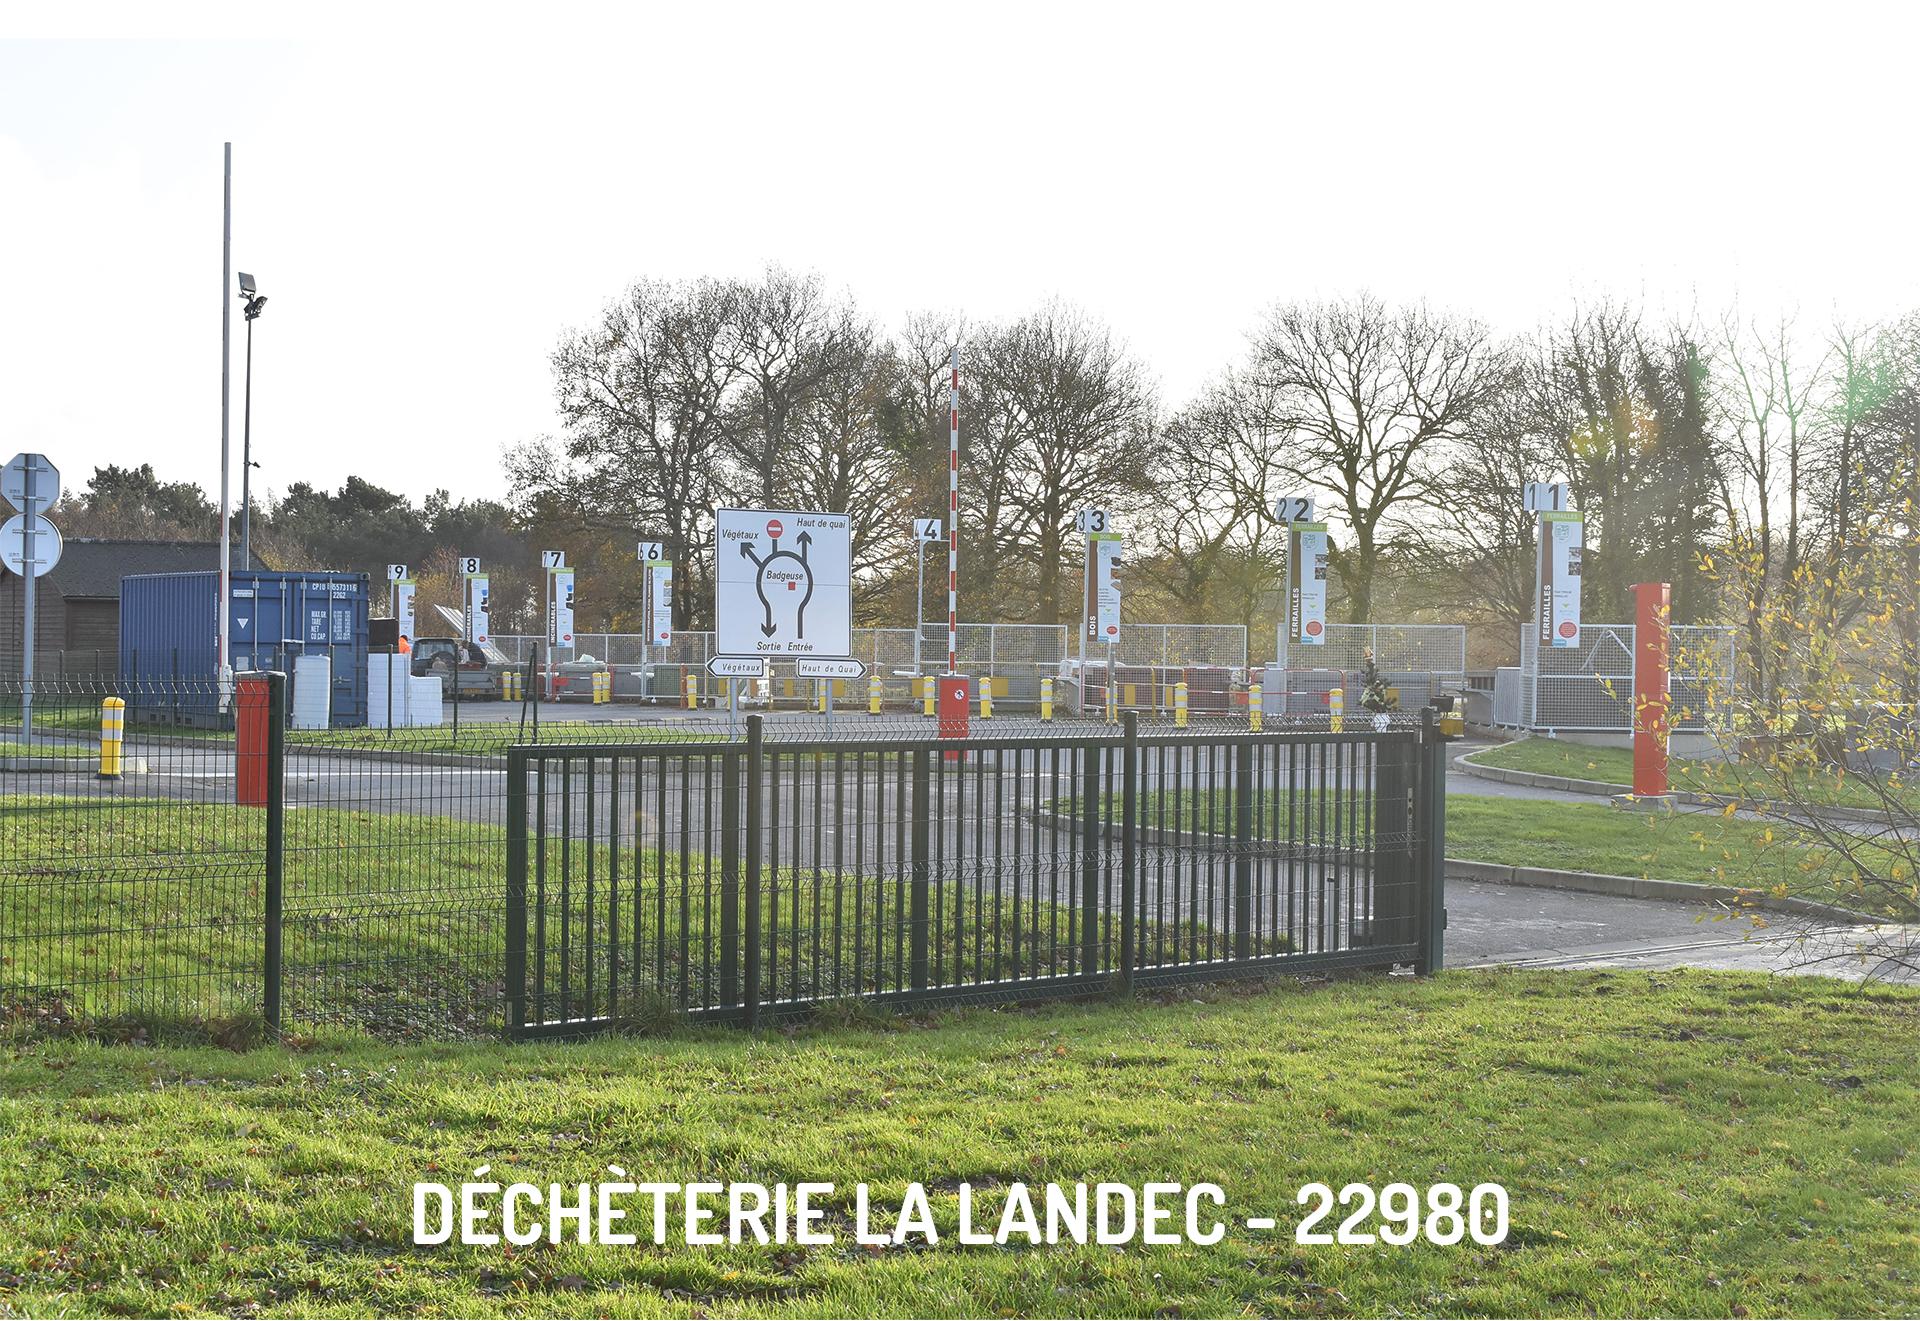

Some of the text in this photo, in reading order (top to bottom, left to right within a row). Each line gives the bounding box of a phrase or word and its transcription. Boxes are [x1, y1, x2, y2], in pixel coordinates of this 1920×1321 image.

[1548, 484, 1559, 511] 1
[1278, 498, 1287, 522] 2
[1294, 498, 1309, 522] 2
[797, 518, 846, 529] Haut de quai
[1078, 511, 1086, 532] 3
[1091, 511, 1105, 532] 3
[722, 529, 759, 540] Végétaux
[924, 520, 937, 539] 4
[551, 552, 561, 567] 7
[648, 544, 658, 560] 6
[395, 565, 404, 579] 9
[467, 558, 476, 573] 8
[766, 570, 804, 582] Badgeuse
[1291, 587, 1299, 638] FERRAILLES
[1542, 584, 1552, 640] FERRAILLES
[756, 641, 814, 651] Sortie Entrée
[722, 663, 760, 672] Végétaux
[801, 665, 857, 674] Haut de Quai
